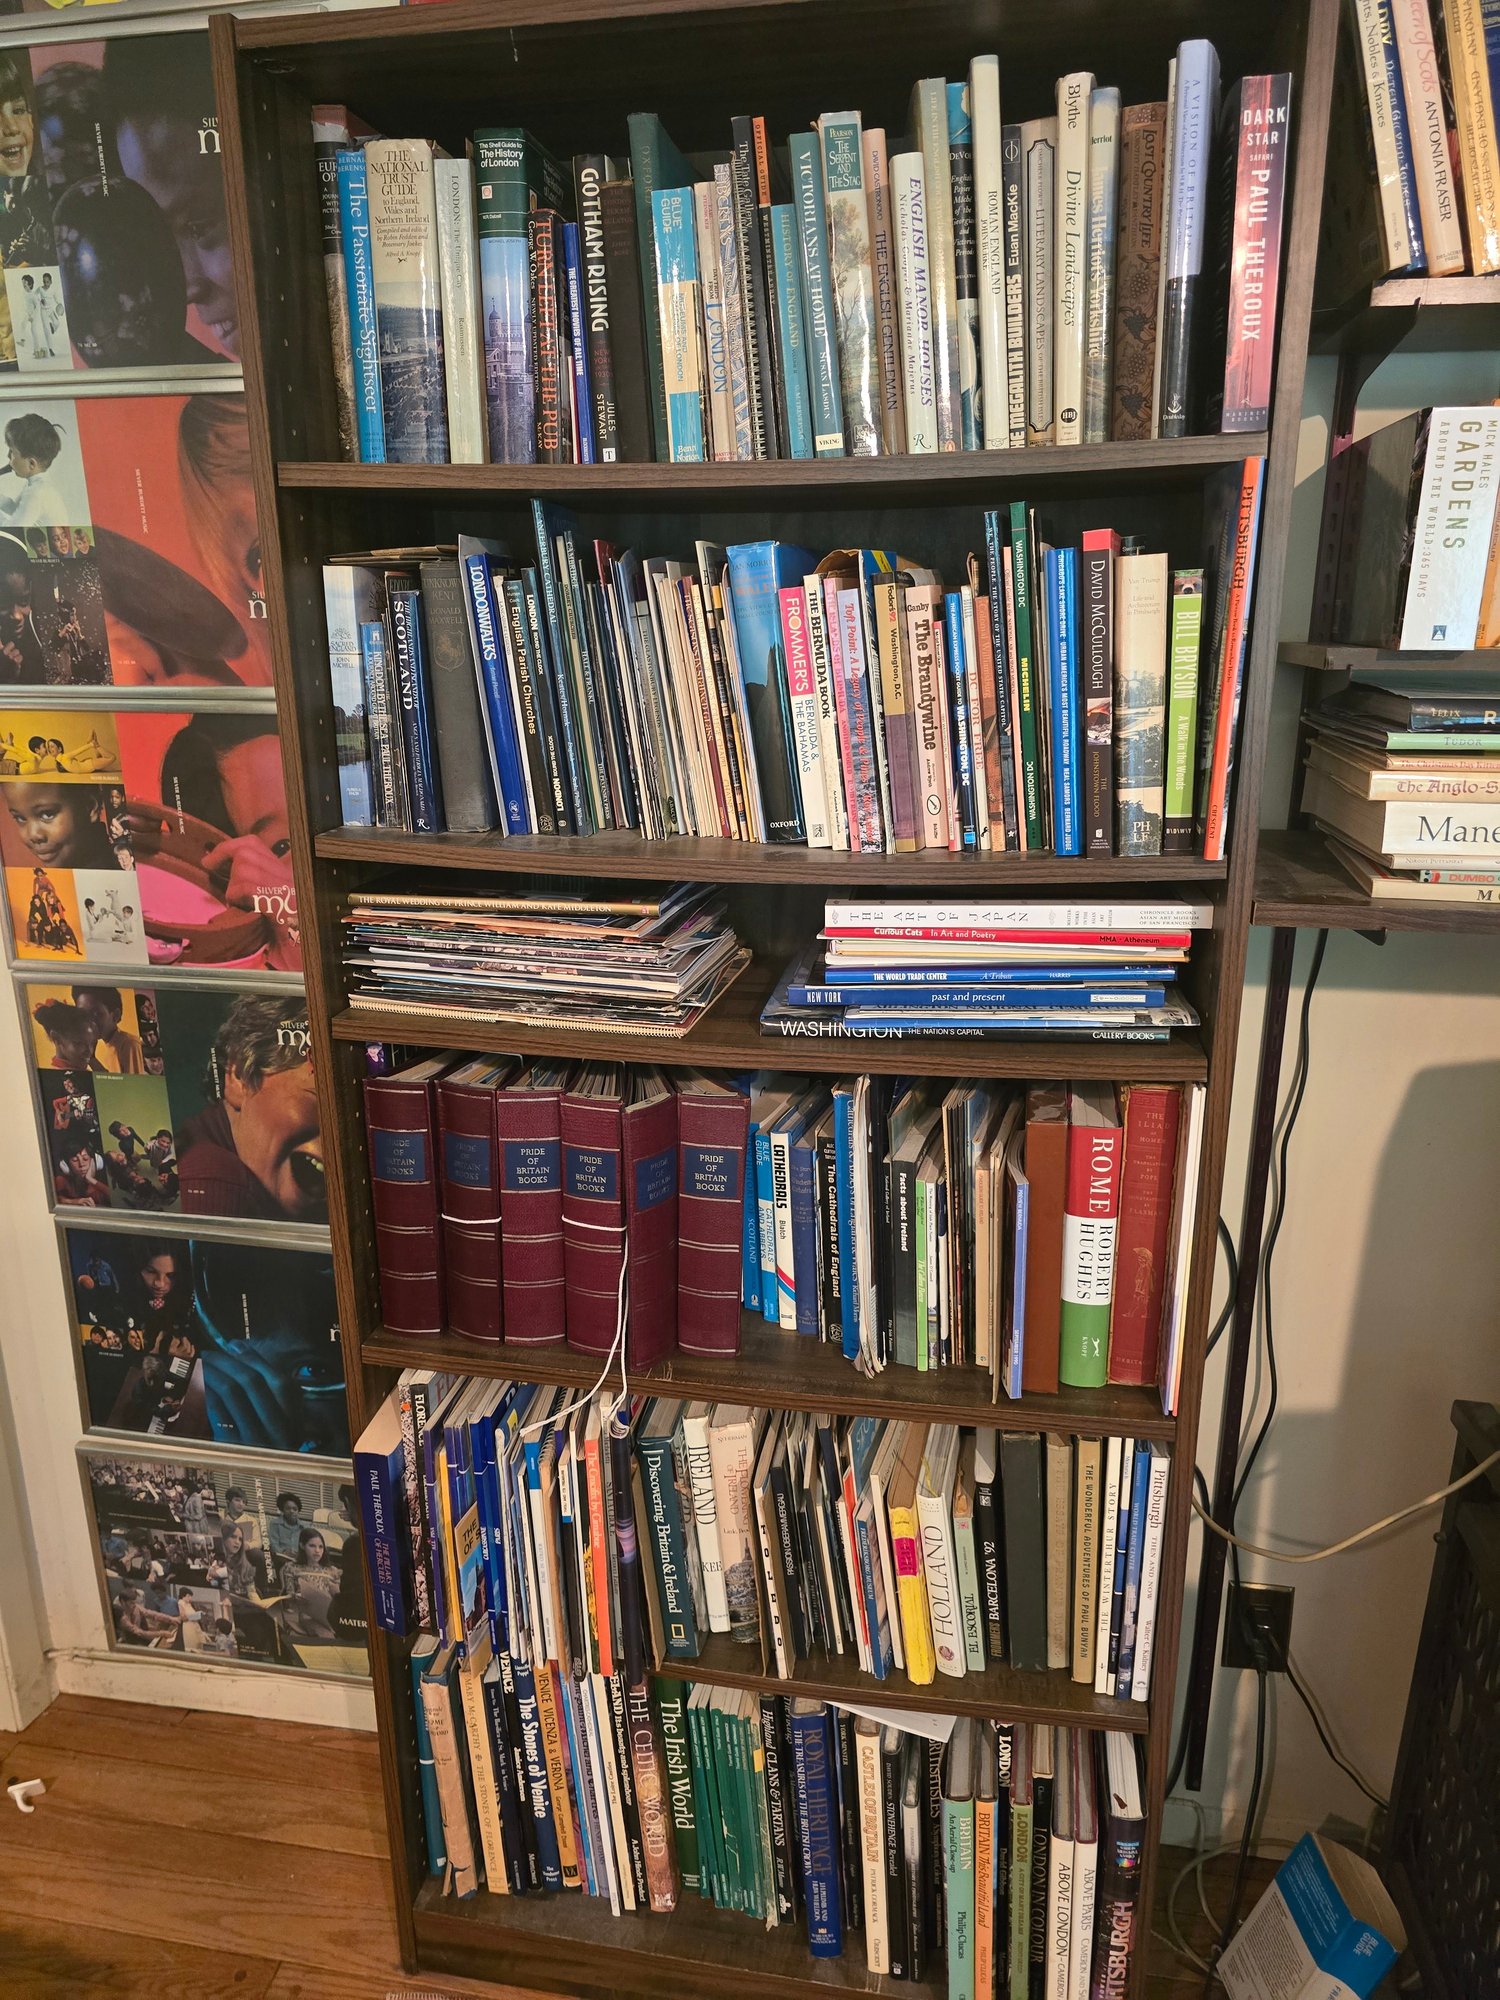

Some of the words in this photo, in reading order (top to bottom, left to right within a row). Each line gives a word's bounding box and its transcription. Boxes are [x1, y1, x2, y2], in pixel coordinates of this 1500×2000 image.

[1066, 84, 1081, 129] Blythe
[1243, 108, 1286, 124] DARK
[739, 141, 750, 160] The
[1247, 133, 1279, 145] STAR
[1425, 100, 1445, 167] ANTONIA
[371, 162, 428, 174] NATIONAL
[384, 150, 412, 162] THE
[480, 150, 493, 158] The
[495, 150, 524, 159] History
[481, 158, 489, 167] of
[491, 158, 519, 167] London
[381, 173, 418, 184] TRUST
[381, 184, 417, 196] GUIDE
[740, 163, 752, 184] Tate
[348, 178, 367, 218] The
[450, 176, 462, 225] LONDON:
[581, 168, 605, 258] GOTHAM
[671, 198, 681, 227] BLUE
[741, 186, 755, 229] Gallery
[798, 151, 820, 255] VICTORIANS
[988, 190, 999, 234] ROMAN
[1064, 170, 1081, 226] Divine
[1248, 169, 1269, 227] PAUL
[1434, 171, 1452, 222] FRASER
[662, 198, 673, 234] GUIDE
[909, 178, 925, 258] ENGLISH
[875, 230, 888, 260] THE
[351, 225, 373, 324] Passionate
[569, 267, 578, 280] THE
[806, 258, 822, 279] AT
[990, 238, 1001, 295] ENGLAND
[1060, 231, 1079, 326] Landscapes
[569, 281, 579, 309] GREATEST
[588, 265, 609, 331] RISING
[877, 264, 892, 320] ENGLISH
[913, 267, 929, 330] MANOR
[1241, 238, 1266, 341] THEROUX
[571, 311, 581, 337] MOVIES
[808, 284, 827, 338] HOME
[574, 347, 582, 356] ALL
[705, 303, 728, 393] LONDON
[819, 352, 829, 379] SUSAN
[358, 329, 379, 414] Sightseer
[574, 358, 583, 376] TIME
[881, 325, 898, 410] GENTLEMAN
[917, 340, 933, 406] HOUSES
[596, 393, 609, 440] STEWART
[606, 401, 616, 431] JULES
[820, 381, 832, 420] LASDUN
[1484, 420, 1498, 447] MICK
[1443, 422, 1482, 549] GARDENS
[1479, 455, 1492, 488] HALES
[1233, 485, 1254, 589] PITTSBURGH
[1015, 540, 1025, 591] WASHINGTON
[1091, 560, 1106, 599] DAVID
[469, 565, 496, 661] LONDONWALKS
[526, 595, 538, 630] LONDON
[808, 590, 819, 614] THE
[1017, 594, 1025, 608] DC
[510, 606, 526, 646] English
[785, 597, 808, 692] FROMMER'S
[914, 619, 931, 651] The
[1176, 612, 1199, 640] BILL
[393, 600, 413, 710] SCOTLAND
[516, 649, 530, 682] Parish
[810, 616, 828, 685] BERMUDA
[890, 628, 900, 682] Washington,
[1021, 657, 1031, 712] MICHELIN
[1174, 646, 1198, 699] BRYSON
[521, 685, 537, 735] Churches
[796, 701, 805, 718] THE
[817, 687, 831, 719] BOOK
[893, 684, 901, 700] D.C.
[916, 655, 937, 750] Brandywine
[805, 699, 819, 750] BERMUDA
[956, 705, 969, 771] WASHINGTON,
[1177, 722, 1187, 739] Walk
[798, 722, 811, 772] BAHAMAS
[1176, 750, 1186, 761] the
[960, 773, 970, 786] DC
[1175, 763, 1186, 790] Woods
[257, 886, 283, 895] SILVER
[1449, 874, 1494, 882] DUMBO
[874, 928, 904, 938] Curious
[906, 928, 923, 938] Cats
[931, 929, 936, 939] In
[938, 929, 953, 939] Art
[956, 929, 969, 939] and
[972, 930, 996, 940] Poetry
[807, 992, 822, 1003] NEW
[825, 992, 842, 1003] YORK
[931, 992, 948, 1003] past
[952, 992, 966, 1003] and
[972, 992, 1006, 1003] present
[520, 1148, 546, 1156] PRIDE
[579, 1156, 602, 1165] PRIDE
[516, 1167, 550, 1175] BRITAIN
[518, 1176, 547, 1184] BOOKS
[575, 1175, 606, 1183] BRITAIN
[577, 1184, 605, 1192] BOOKS
[773, 1145, 787, 1208] CATHEDRALS
[828, 1165, 837, 1183] The
[1089, 1137, 1114, 1213] ROME
[828, 1186, 839, 1242] Cathedrals
[900, 1197, 908, 1220] about
[830, 1244, 839, 1254] of
[900, 1223, 908, 1251] Ireland
[830, 1256, 841, 1297] England
[1077, 1223, 1094, 1300] HUGHES
[1095, 1225, 1113, 1299] ROBERT
[370, 1470, 380, 1490] PAUL
[647, 1456, 670, 1522] Discovering
[688, 1446, 717, 1524] IRELAND
[1085, 1465, 1093, 1480] THE
[372, 1494, 384, 1535] THEROUX
[1084, 1484, 1093, 1532] WONDERFUL
[1149, 1469, 1166, 1529] Pittsburgh
[656, 1524, 675, 1563] Britain
[661, 1564, 676, 1574] &
[923, 1526, 954, 1636] HOLLAND
[1082, 1536, 1091, 1589] ADVENTURES
[663, 1575, 682, 1613] Ireland
[985, 1559, 999, 1620] BARCELONA
[1082, 1592, 1090, 1602] OF
[1081, 1605, 1089, 1624] PAUL
[1080, 1627, 1088, 1658] BUNYAN
[500, 1651, 515, 1694] VENICE
[538, 1673, 552, 1703] VENICE
[519, 1696, 537, 1720] The
[630, 1687, 649, 1722] THE
[660, 1699, 684, 1734] The
[522, 1723, 541, 1762] Stones
[543, 1709, 557, 1745] VICENZA
[527, 1765, 543, 1777] of
[549, 1757, 563, 1791] VERONA
[635, 1730, 656, 1786] CELTIC
[665, 1737, 688, 1774] Irish
[999, 1735, 1011, 1787] LONDON
[529, 1781, 547, 1818] Venice
[670, 1777, 694, 1829] World
[642, 1795, 665, 1857] WORLD
[887, 1802, 896, 1847] STONEHENGE
[889, 1849, 897, 1876] Revealed
[1057, 1863, 1070, 1903] ABOVE
[957, 1911, 966, 1933] Philip
[957, 1935, 966, 1959] Clucas
